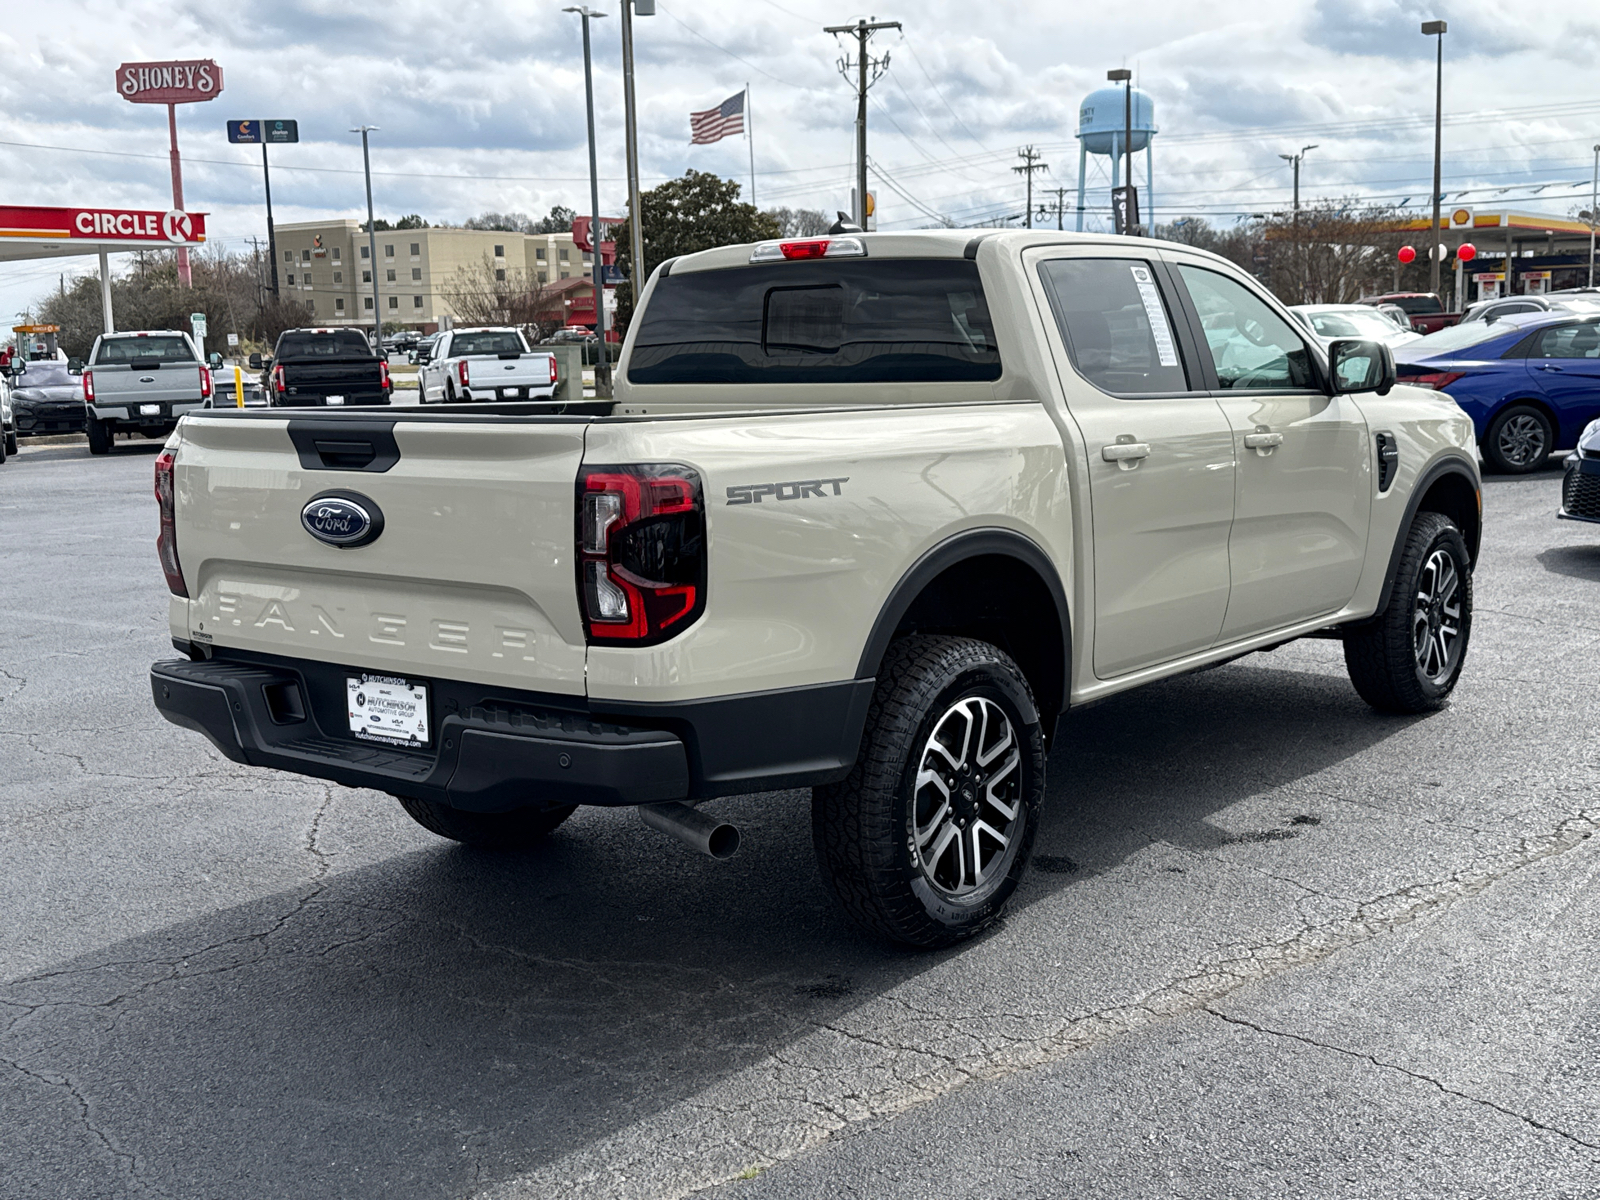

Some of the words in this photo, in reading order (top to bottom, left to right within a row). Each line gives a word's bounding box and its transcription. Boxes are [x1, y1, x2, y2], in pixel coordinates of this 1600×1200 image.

[122, 65, 214, 95] SHONEY'S
[75, 212, 158, 235] CIRCLE
[169, 214, 191, 240] K
[726, 477, 850, 505] SPORT
[315, 506, 352, 532] Ford
[212, 593, 537, 662] RANGER
[368, 675, 406, 686] HUTCHINSON
[367, 696, 416, 711] HUTCHINSON
[368, 707, 397, 716] AUTOMOTIVE
[398, 710, 415, 718] GROUP
